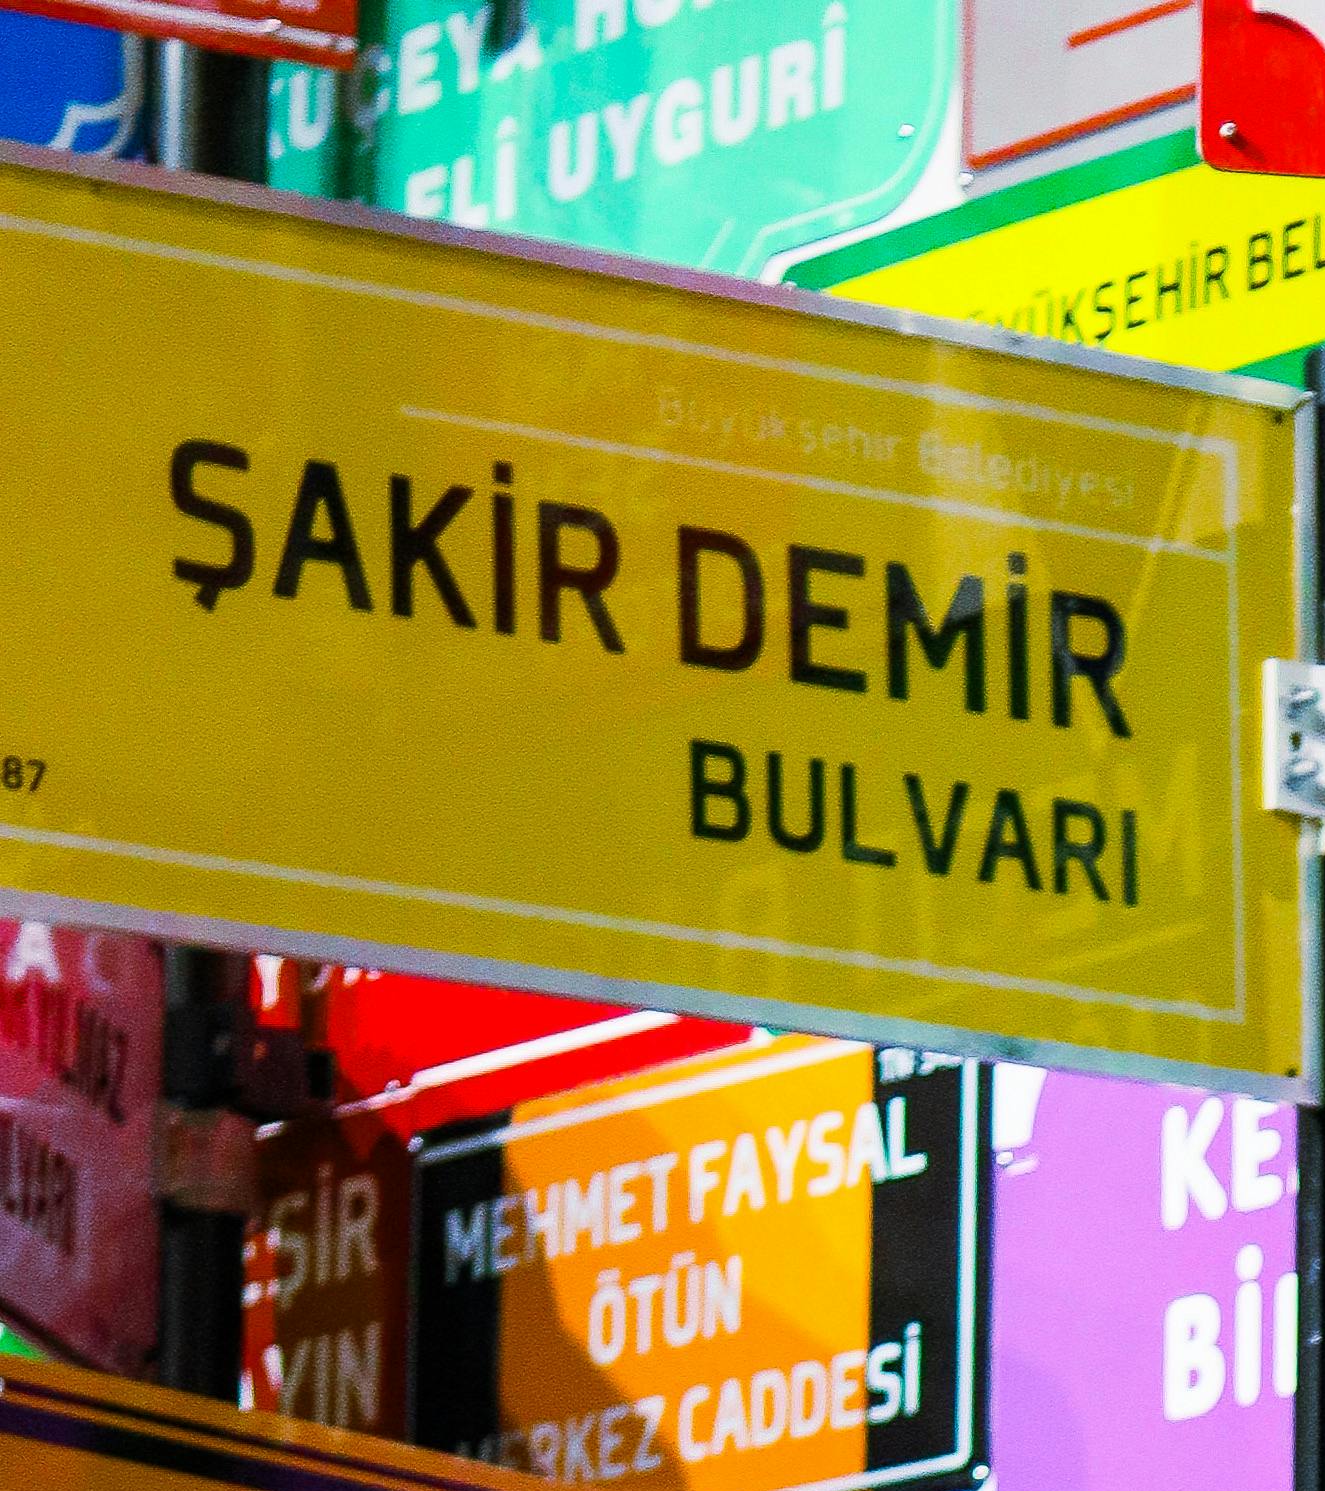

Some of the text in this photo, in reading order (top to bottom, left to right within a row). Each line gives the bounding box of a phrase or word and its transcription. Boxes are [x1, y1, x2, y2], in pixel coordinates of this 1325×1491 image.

[168, 437, 1132, 738] ŞAKİR DEMİR
[688, 739, 1140, 907] BULVARI
[444, 1154, 680, 1287] MEHMET
[689, 1095, 929, 1220] FAYSAL
[587, 1251, 743, 1367] ÖTÜN
[680, 1322, 921, 1463] CADDESİ
